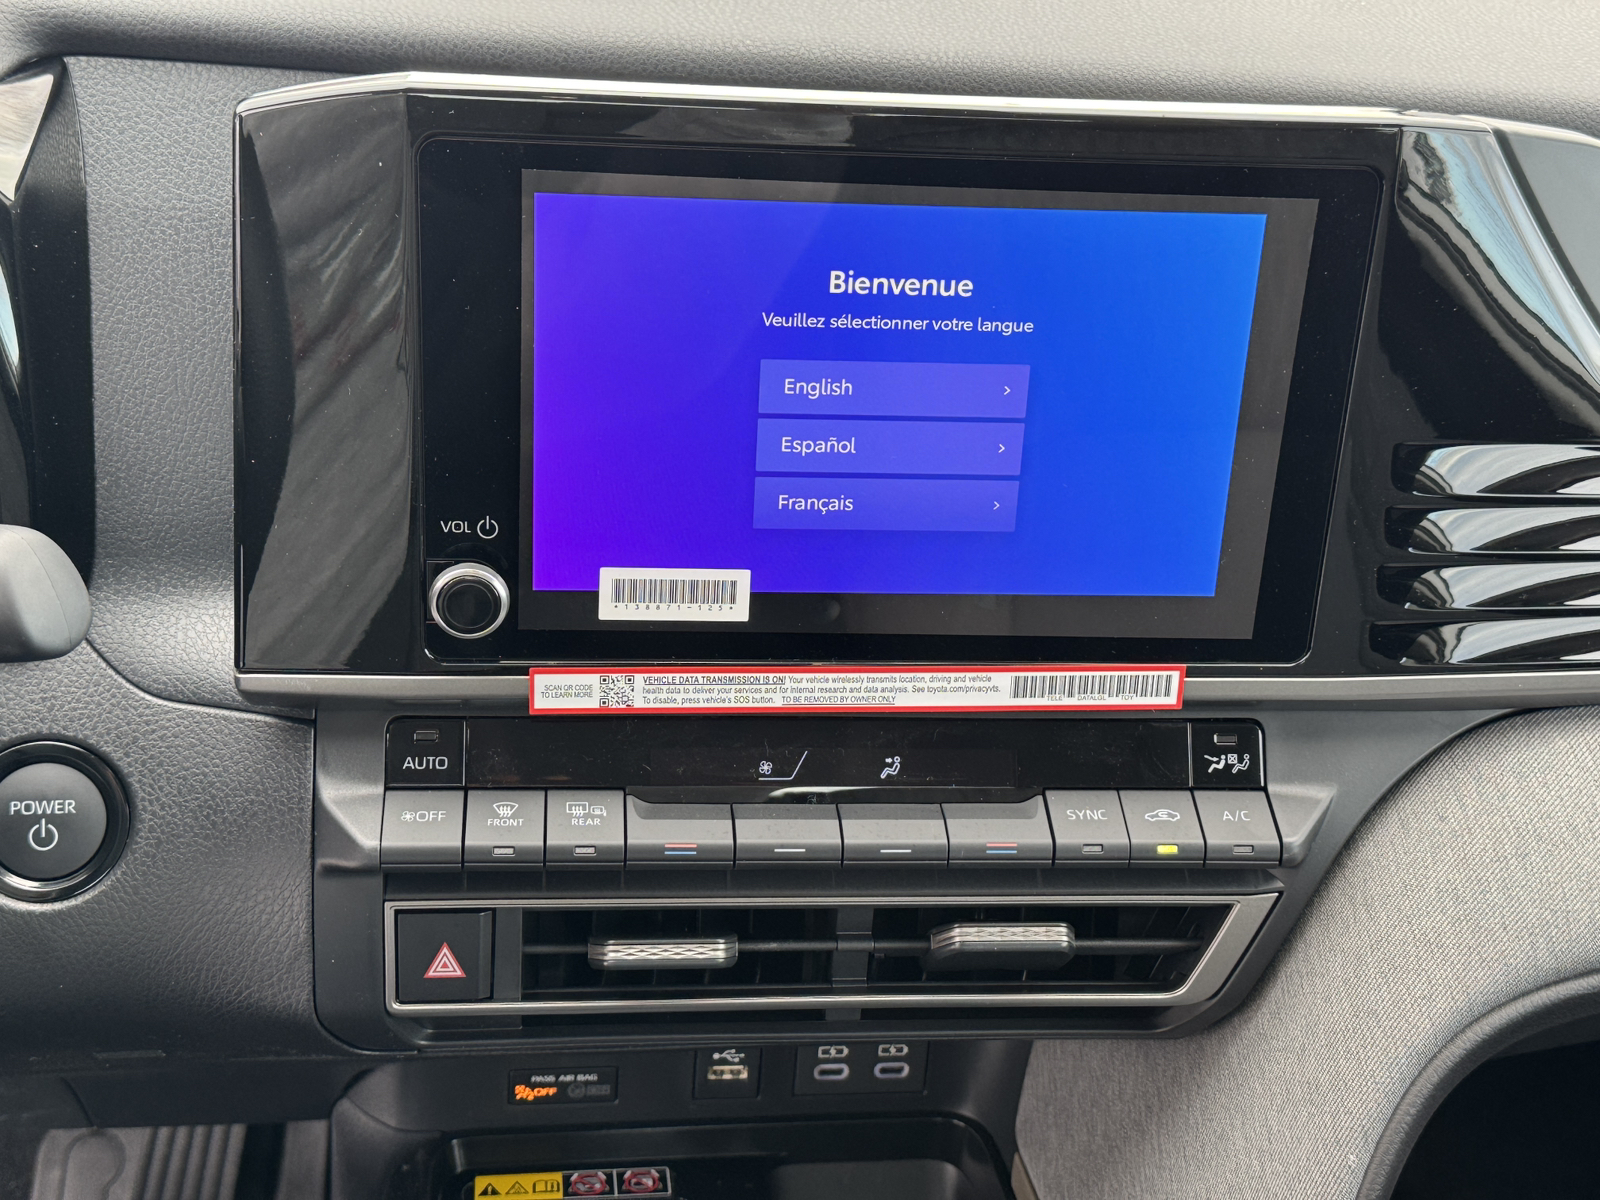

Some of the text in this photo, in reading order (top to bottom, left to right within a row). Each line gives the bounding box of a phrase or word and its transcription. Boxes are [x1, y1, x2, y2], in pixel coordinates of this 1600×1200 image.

[829, 270, 974, 297] Bienvenue
[762, 312, 1034, 336] Veuillez sélectionner votre langue
[784, 378, 853, 400] English
[781, 436, 856, 456] Español
[778, 494, 854, 515] Français
[440, 520, 471, 533] VOL
[642, 674, 992, 686] VEHICLE DATA TRANSMISSION IS ON! Your vehicle wirelessly transmits location, driving and vehicle
[544, 684, 593, 692] SCAN QR CODE
[642, 686, 664, 694] health
[666, 686, 680, 694] data
[683, 686, 690, 694] to
[692, 686, 715, 694] deliver
[716, 687, 732, 695] your
[734, 686, 762, 694] services
[764, 686, 777, 694] and
[790, 686, 816, 694] internal
[817, 686, 847, 694] research
[880, 685, 910, 694] analysis.
[926, 684, 1001, 694] toyota.com/privacyvts.
[642, 696, 650, 704] To
[652, 696, 680, 705] disable,
[681, 697, 700, 705] press
[734, 696, 750, 704] SOS
[402, 756, 448, 770] AUTO
[9, 799, 76, 815] POWER
[416, 810, 447, 822] OFF
[1066, 809, 1108, 820] SYNC
[1222, 809, 1251, 821] A/C
[487, 818, 524, 827] FRONT
[571, 817, 601, 826] REAR
[533, 1086, 558, 1096] OFF
